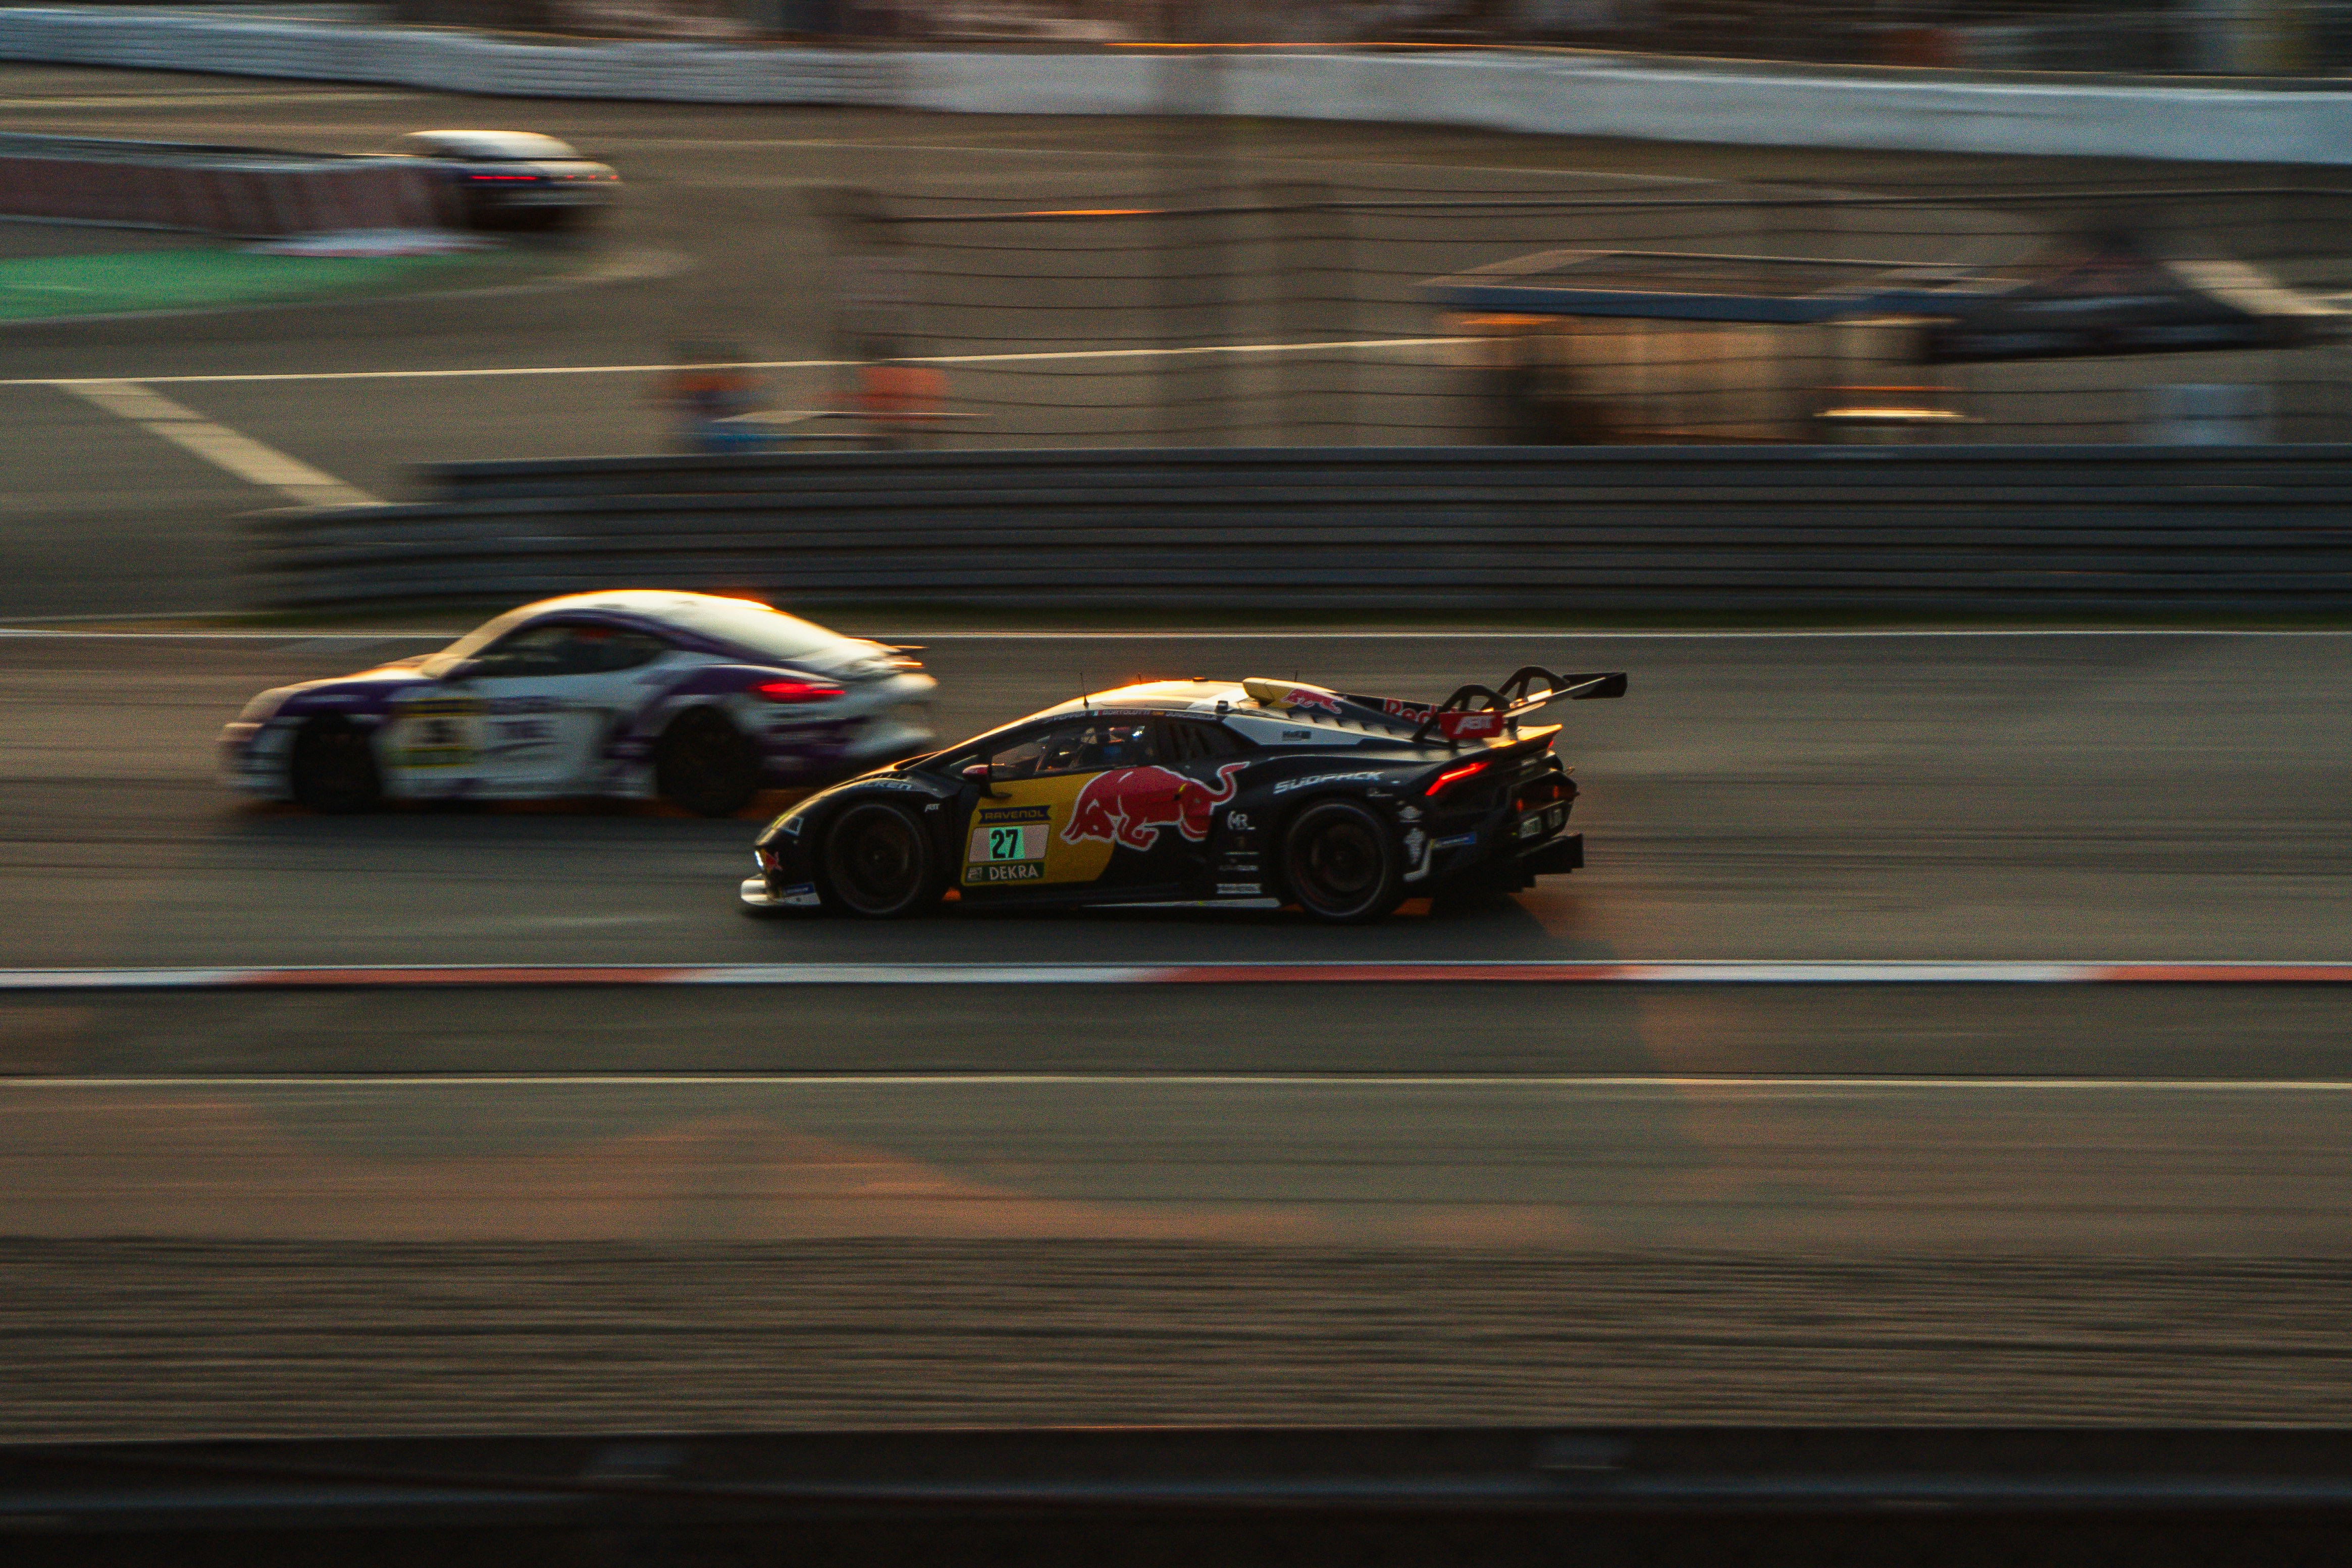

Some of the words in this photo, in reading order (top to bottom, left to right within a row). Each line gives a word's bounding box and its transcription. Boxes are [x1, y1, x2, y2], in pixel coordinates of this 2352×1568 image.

[1453, 715, 1495, 735] ABT
[984, 810, 1044, 820] RAVENOL
[991, 829, 1018, 859] 27
[989, 864, 1039, 881] DEKRA
